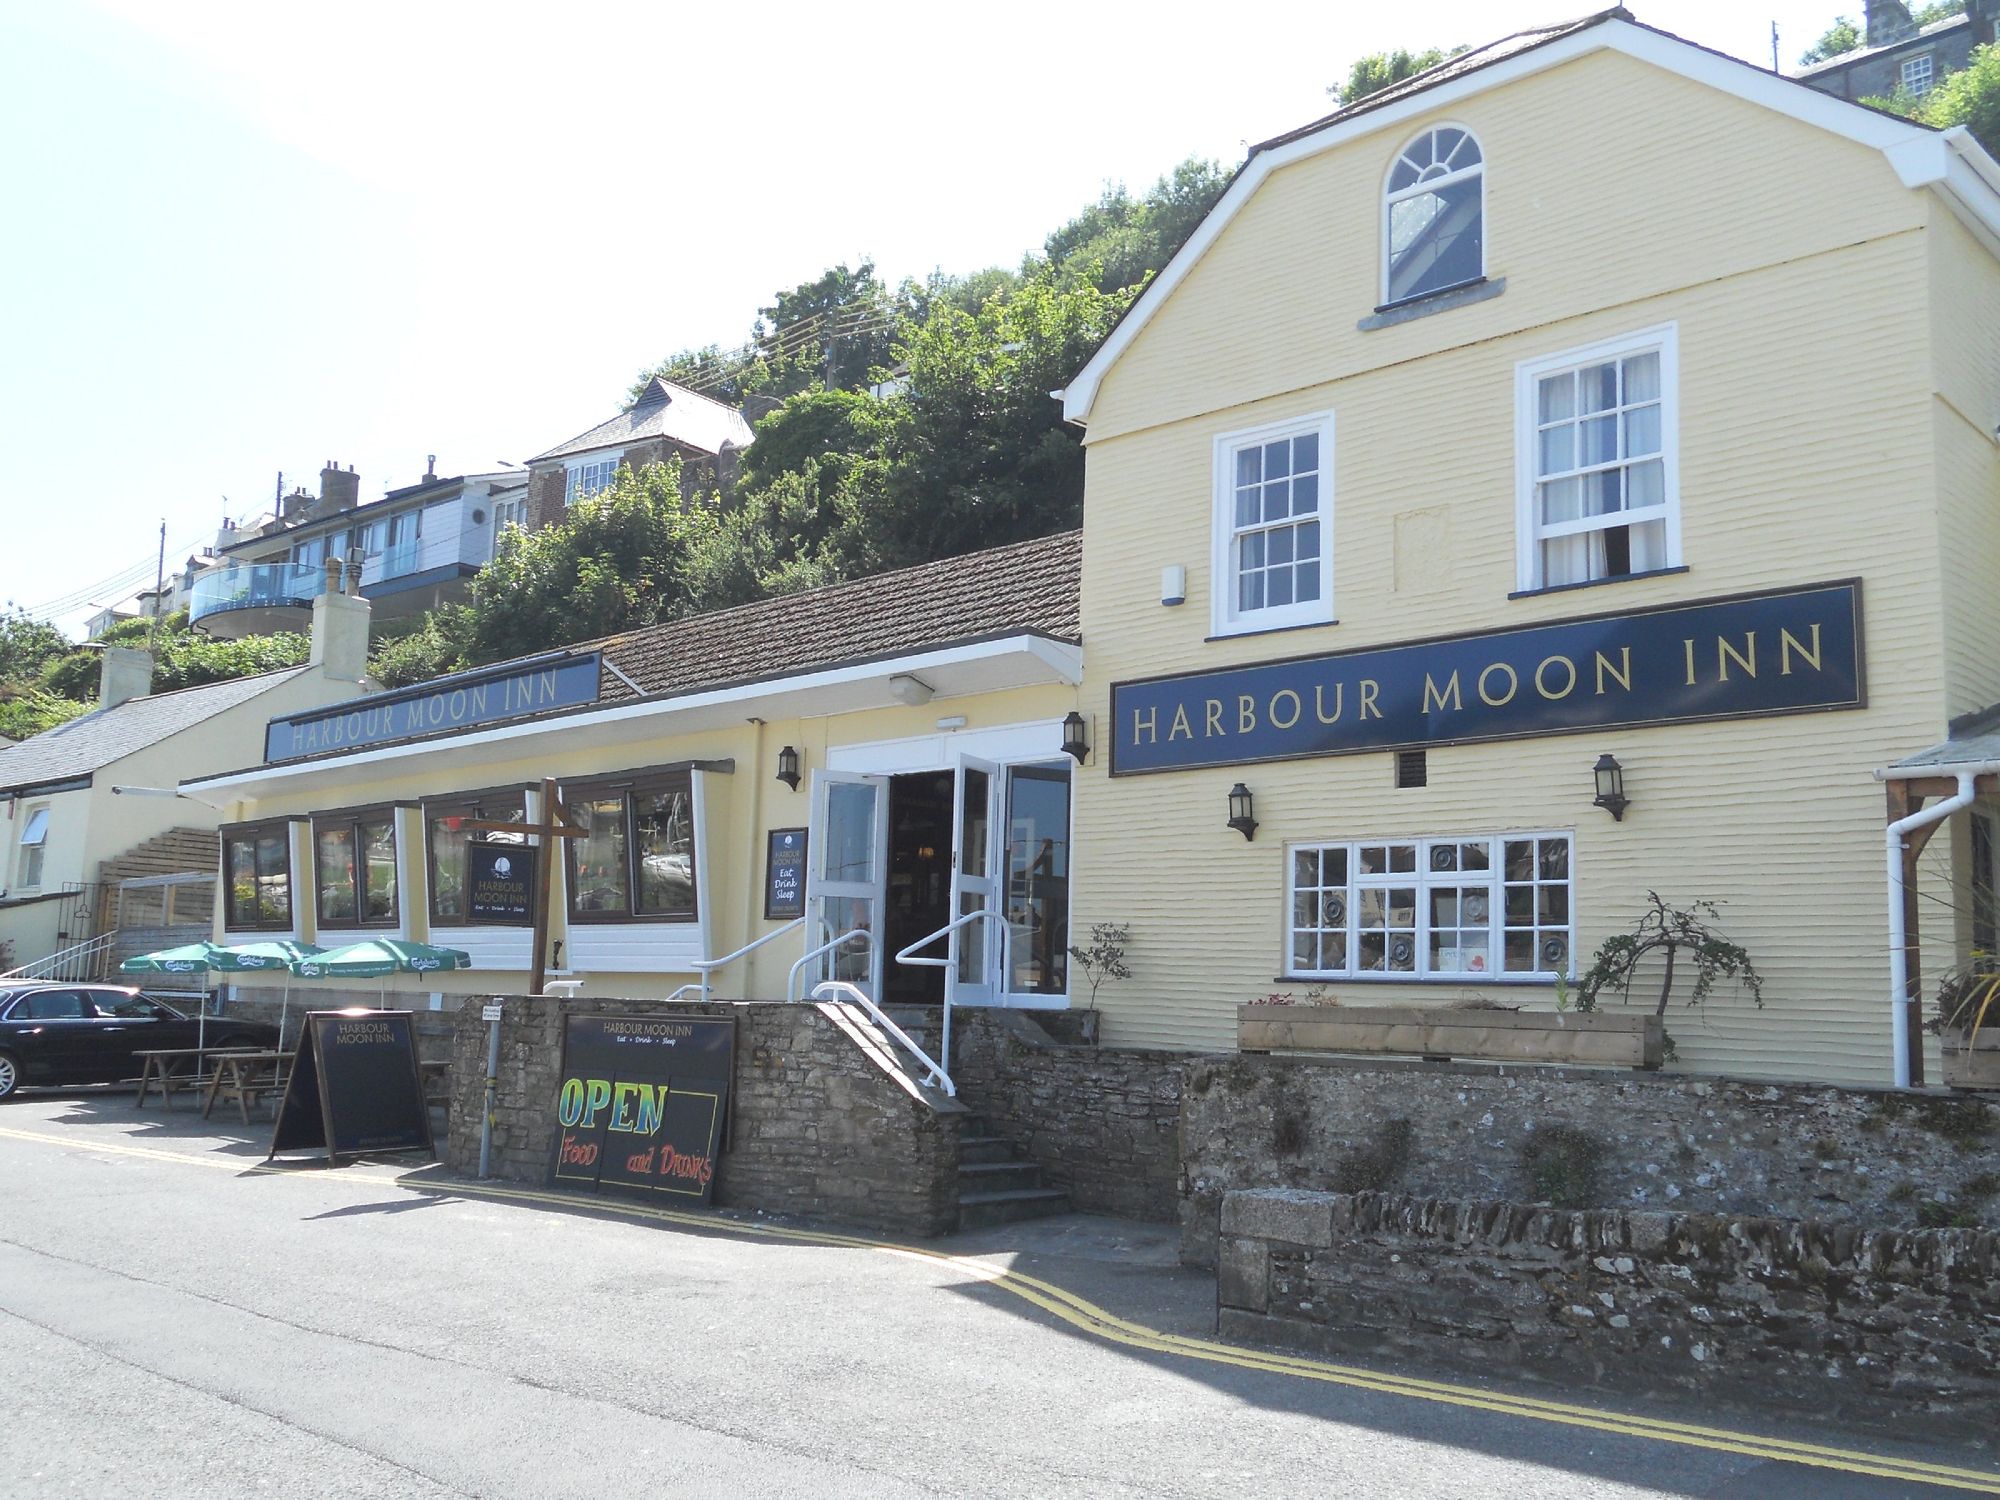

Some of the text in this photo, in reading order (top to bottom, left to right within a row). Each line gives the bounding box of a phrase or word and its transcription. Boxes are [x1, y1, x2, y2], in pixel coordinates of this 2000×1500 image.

[1133, 623, 1821, 746] HARBOUR MOON INN
[291, 669, 557, 750] HARBOUR MOON INN
[780, 868, 794, 877] Eat
[479, 881, 524, 892] HARBOUR
[775, 878, 797, 889] Drink
[473, 892, 527, 904] MOON INN
[776, 889, 795, 901] Sleep
[165, 960, 194, 972] Carlsberg
[237, 954, 265, 966] Carlsberg
[411, 957, 440, 970] Carlsberg
[340, 1023, 389, 1034] HARBOUR
[603, 1022, 692, 1036] HARBOUR MOON INN
[337, 1033, 395, 1044] MOON INN
[662, 1037, 676, 1046] Sleep
[558, 1078, 669, 1137] OPEN
[626, 1147, 656, 1174] and
